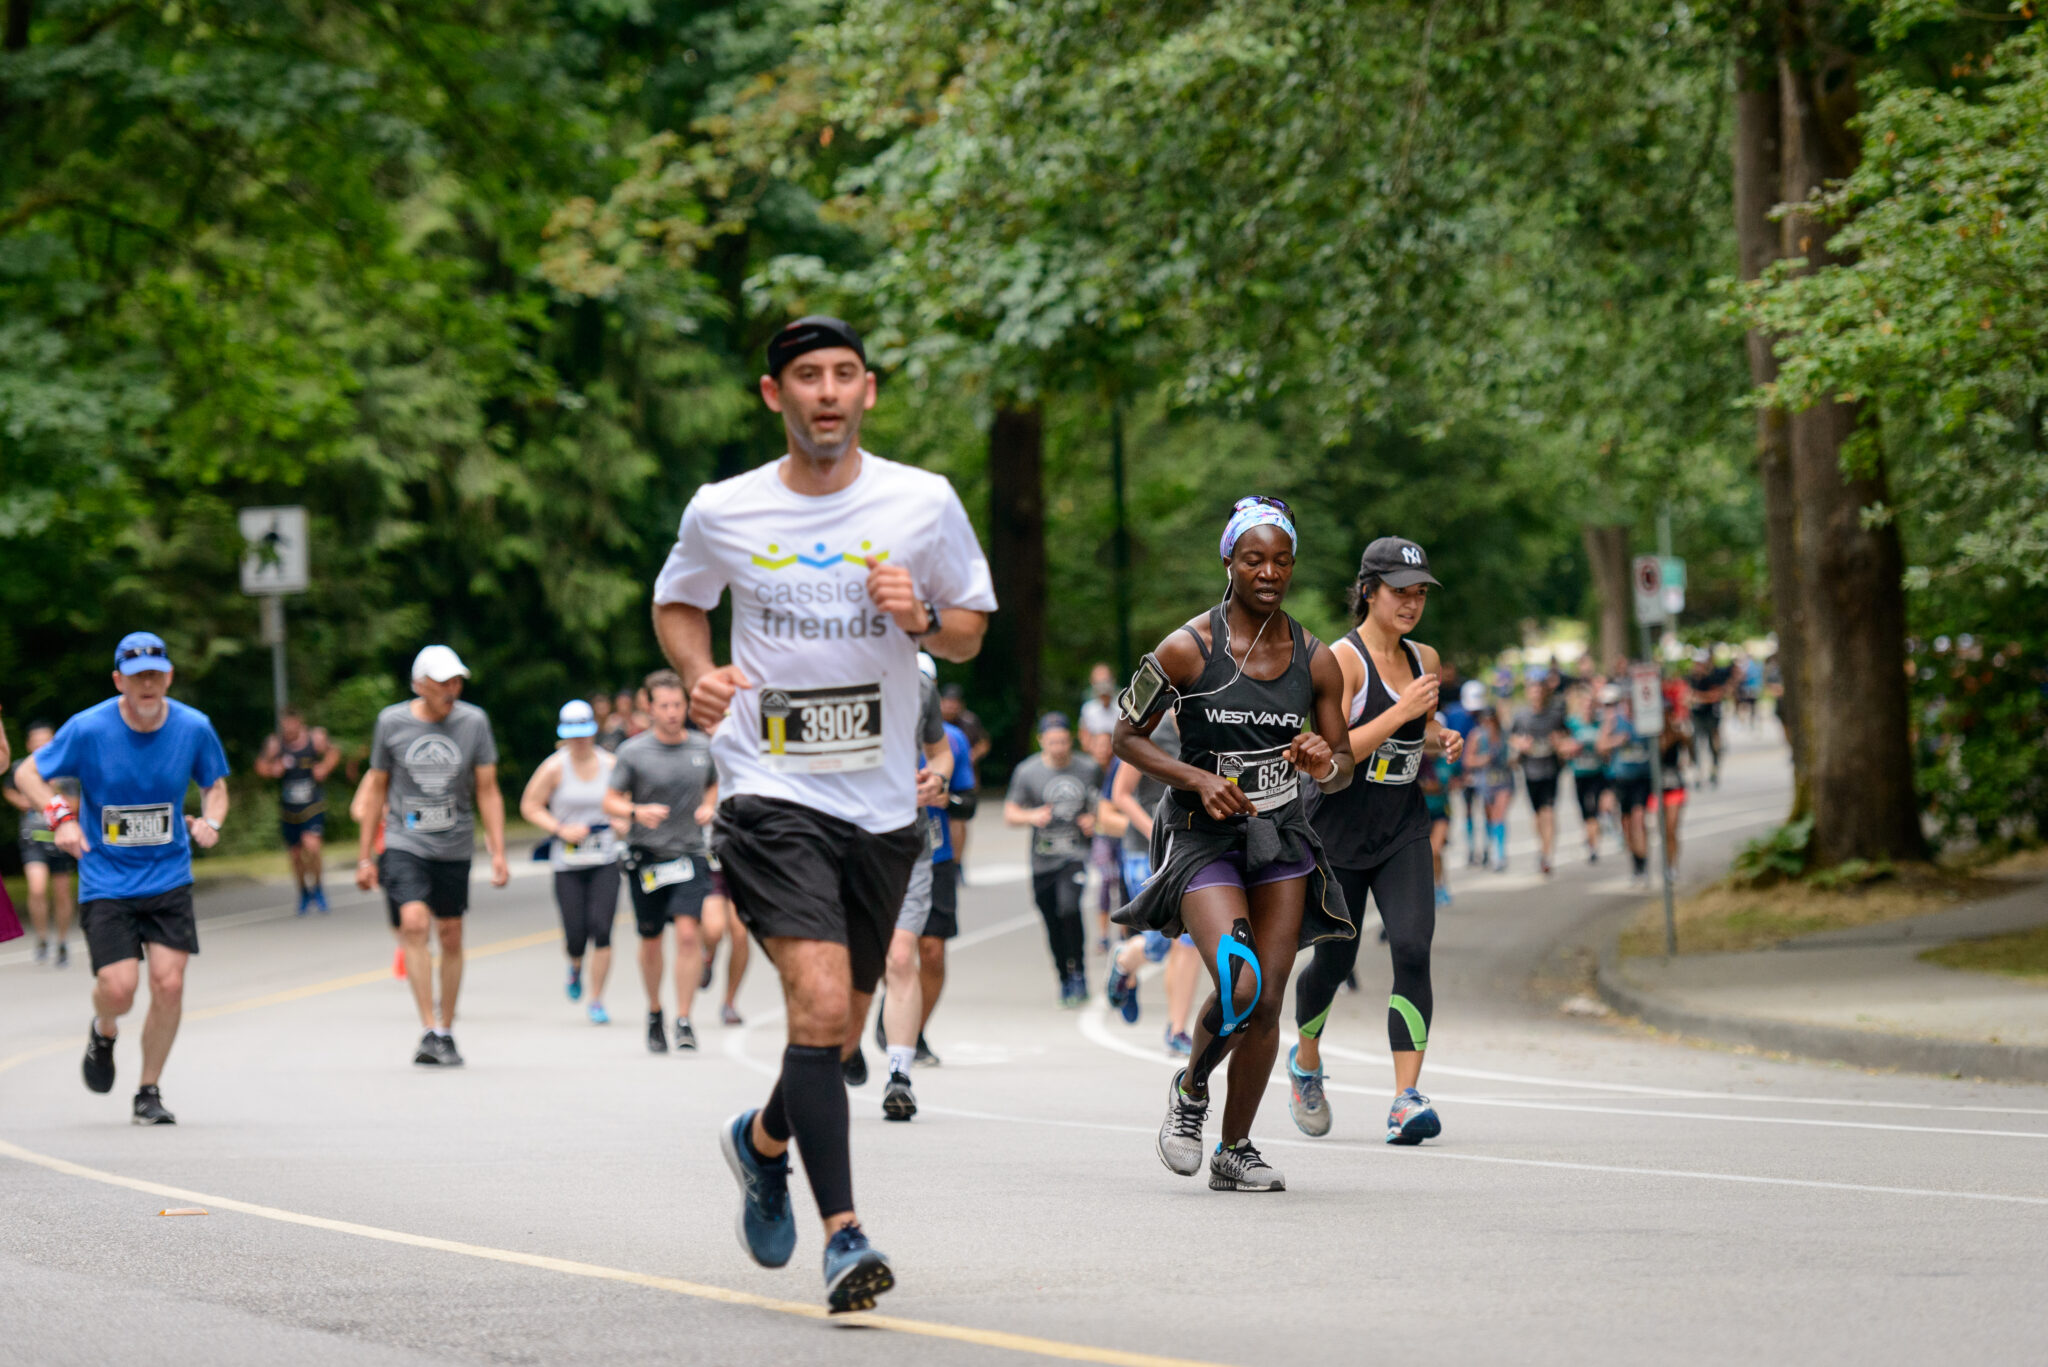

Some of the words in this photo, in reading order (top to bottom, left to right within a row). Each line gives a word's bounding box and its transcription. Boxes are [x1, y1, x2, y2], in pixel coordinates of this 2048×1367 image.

[761, 608, 887, 640] friends
[801, 702, 870, 742] 3902
[1258, 759, 1289, 791] 652
